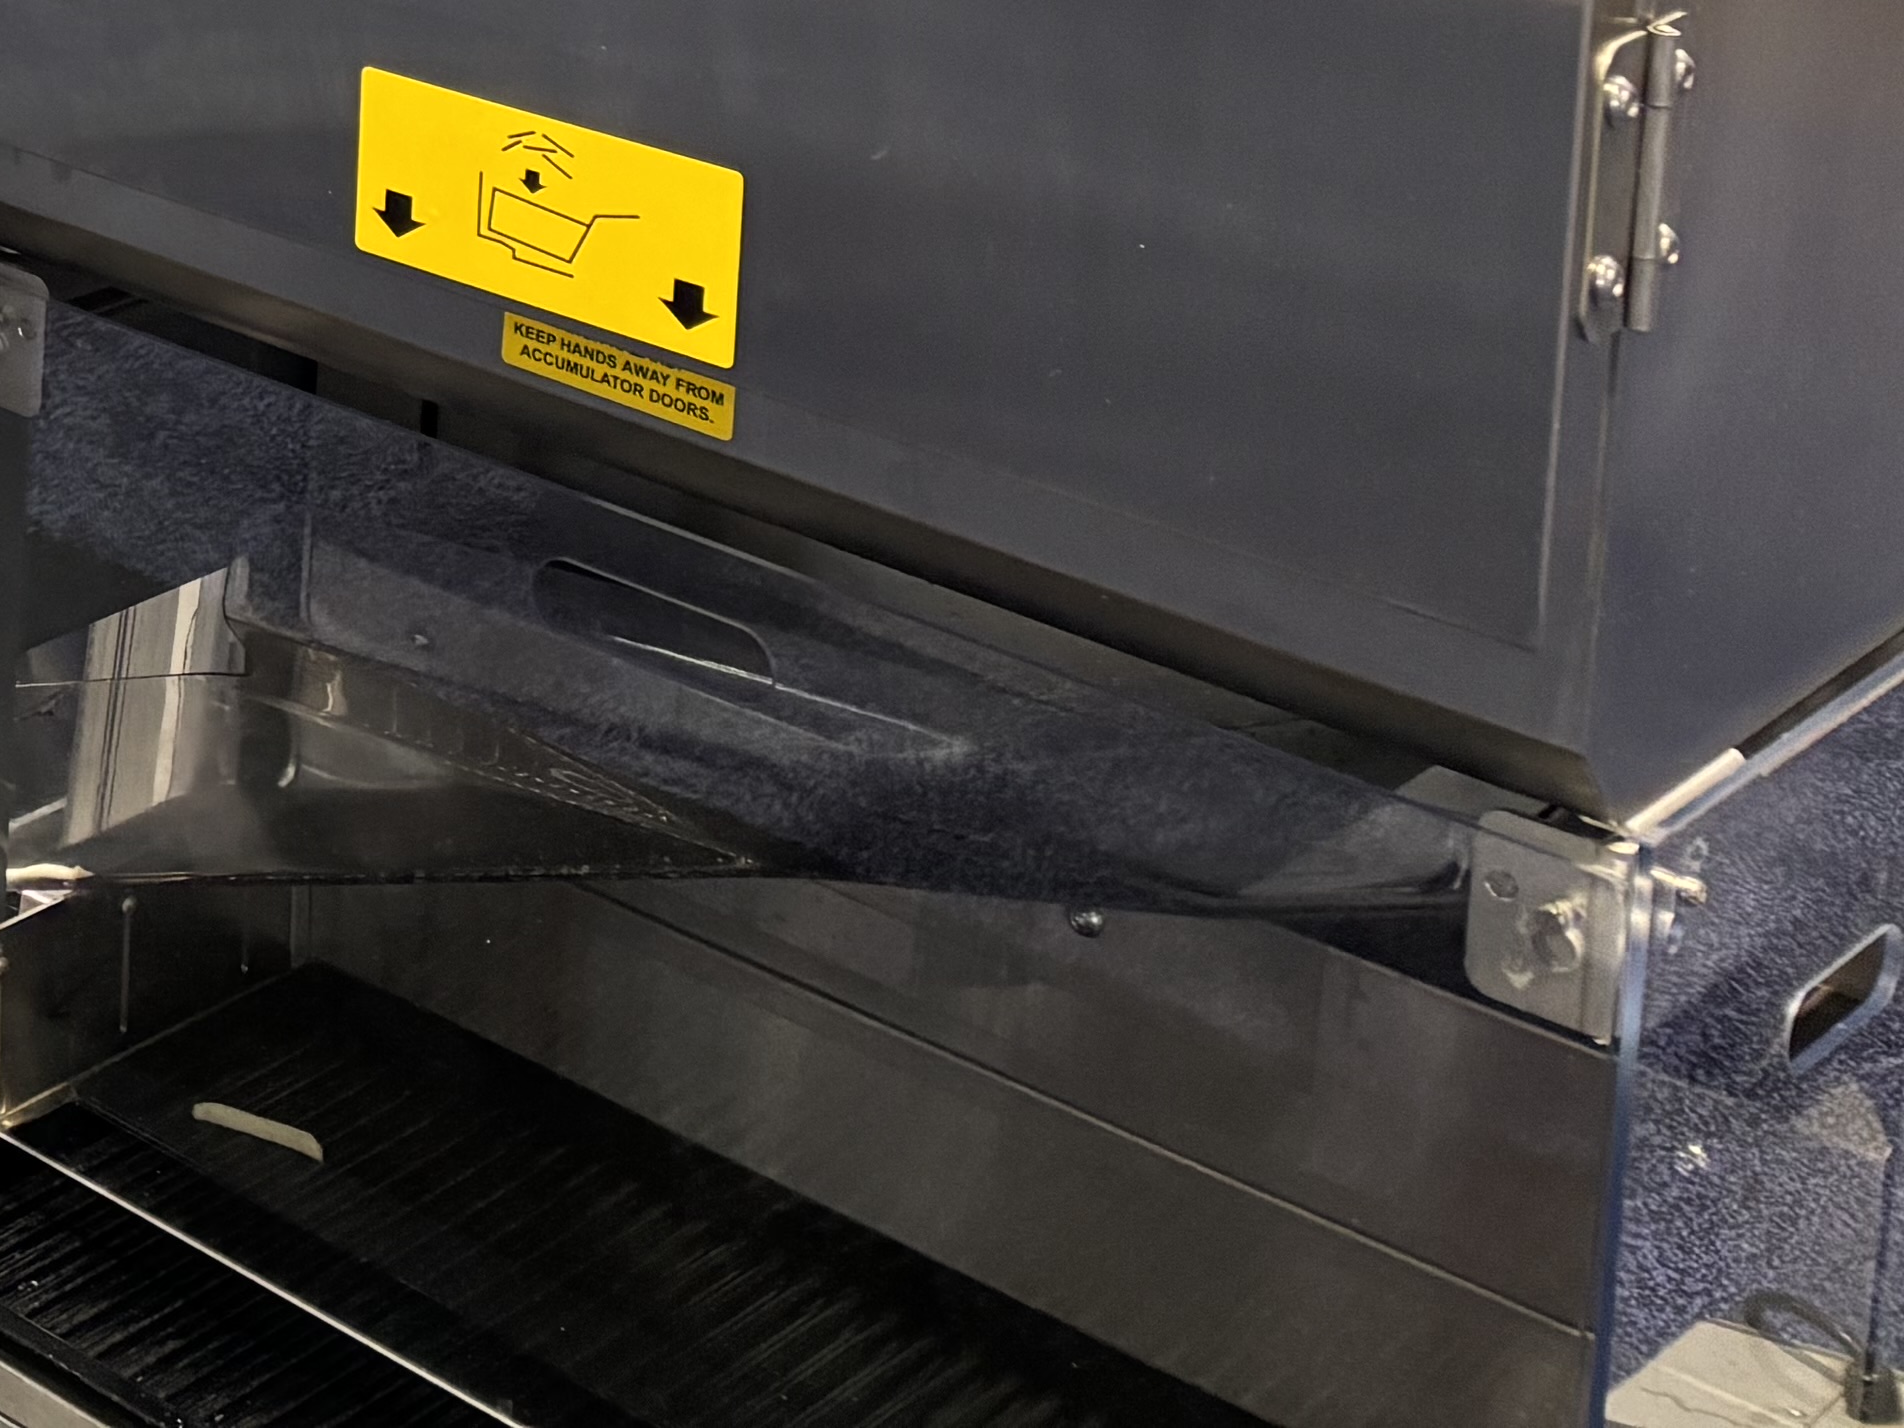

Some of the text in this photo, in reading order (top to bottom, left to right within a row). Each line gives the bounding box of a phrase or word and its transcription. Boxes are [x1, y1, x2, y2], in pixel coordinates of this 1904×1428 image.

[513, 321, 725, 406] KEEP HANDS AWAY FROM
[519, 344, 715, 424] ACCUMULATOR DOORS.
